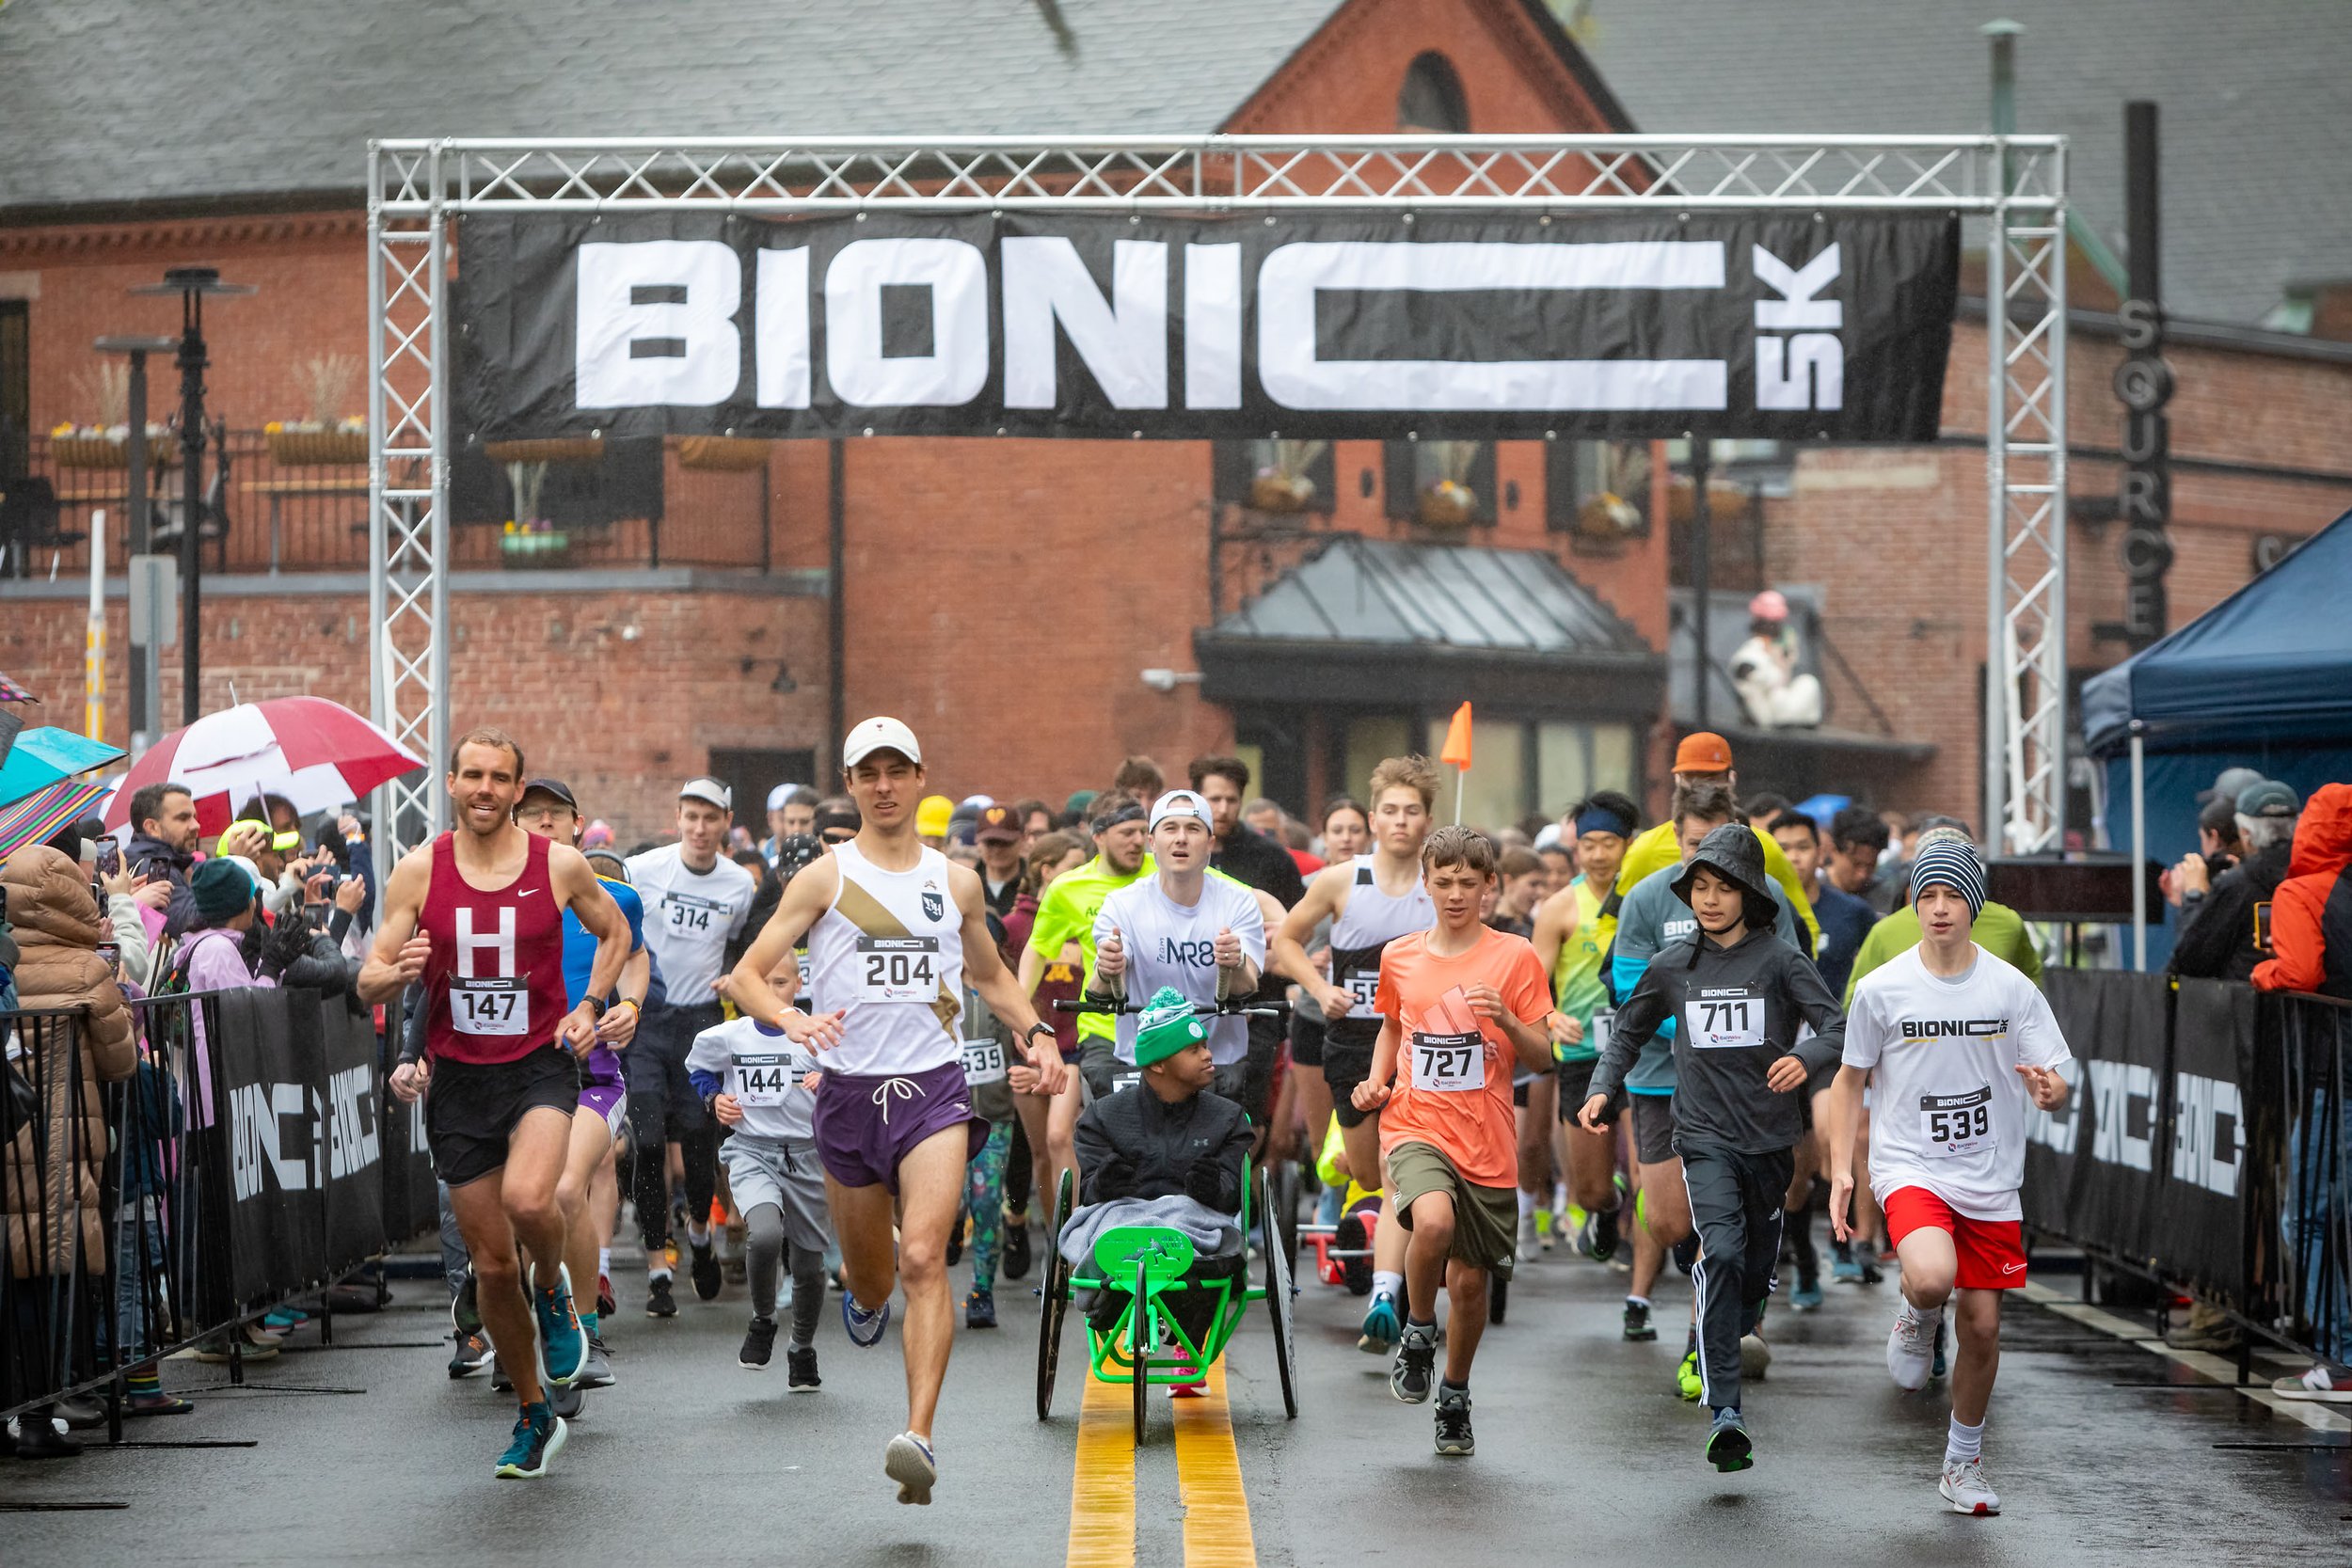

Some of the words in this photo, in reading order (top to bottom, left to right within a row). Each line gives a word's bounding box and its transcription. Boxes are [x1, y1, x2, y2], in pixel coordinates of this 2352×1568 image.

[576, 236, 1727, 410] BIONIC
[1752, 241, 1844, 409] 5K
[2115, 298, 2162, 636] SOURCE
[672, 905, 709, 930] 314
[455, 907, 516, 977] H
[866, 955, 933, 986] 204
[1701, 988, 1744, 997] BIONIC
[462, 993, 516, 1021] 147
[1700, 1002, 1749, 1032] 711
[1423, 1036, 1462, 1045] BIONIC
[1901, 1019, 1999, 1037] BIONIC
[1420, 1049, 1472, 1077] 727
[739, 1069, 785, 1093] 144
[1937, 1093, 1979, 1106] BIONIC
[1931, 1105, 1988, 1143] 539
